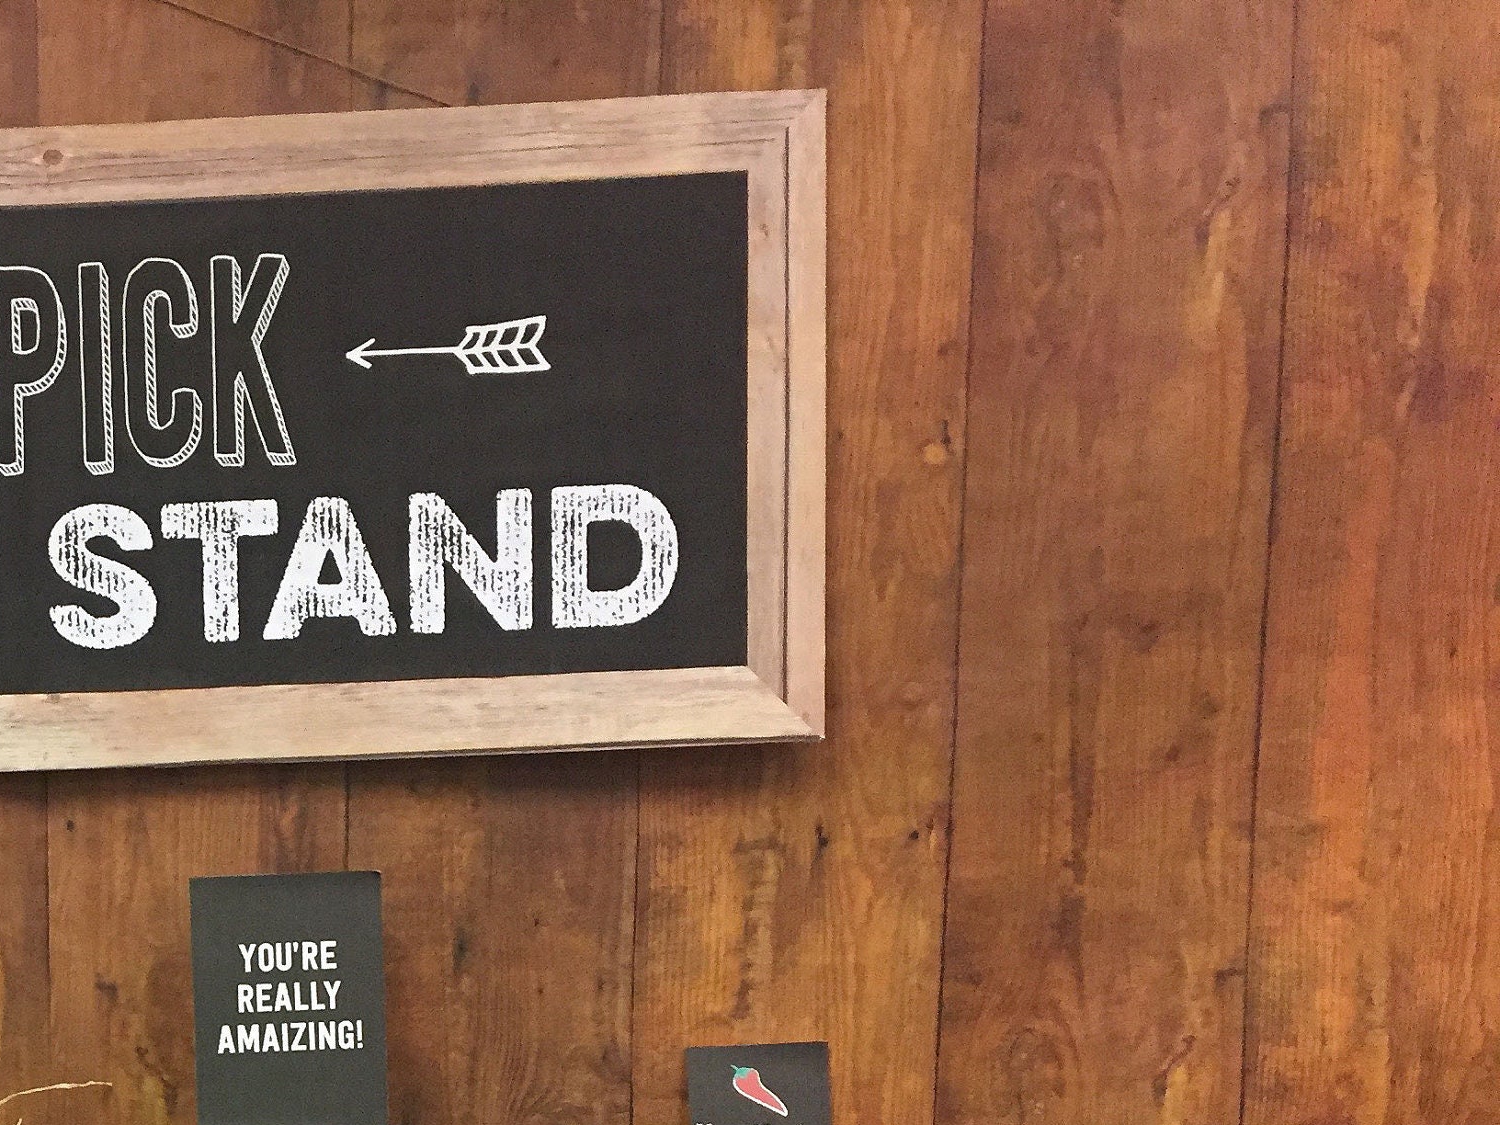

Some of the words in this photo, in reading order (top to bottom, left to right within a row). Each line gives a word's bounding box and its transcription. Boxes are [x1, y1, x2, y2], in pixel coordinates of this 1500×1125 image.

[47, 483, 680, 650] STAND
[238, 940, 338, 973] YOU'RE
[237, 980, 342, 1014] REALLY
[217, 1019, 364, 1055] AMAIZING!
